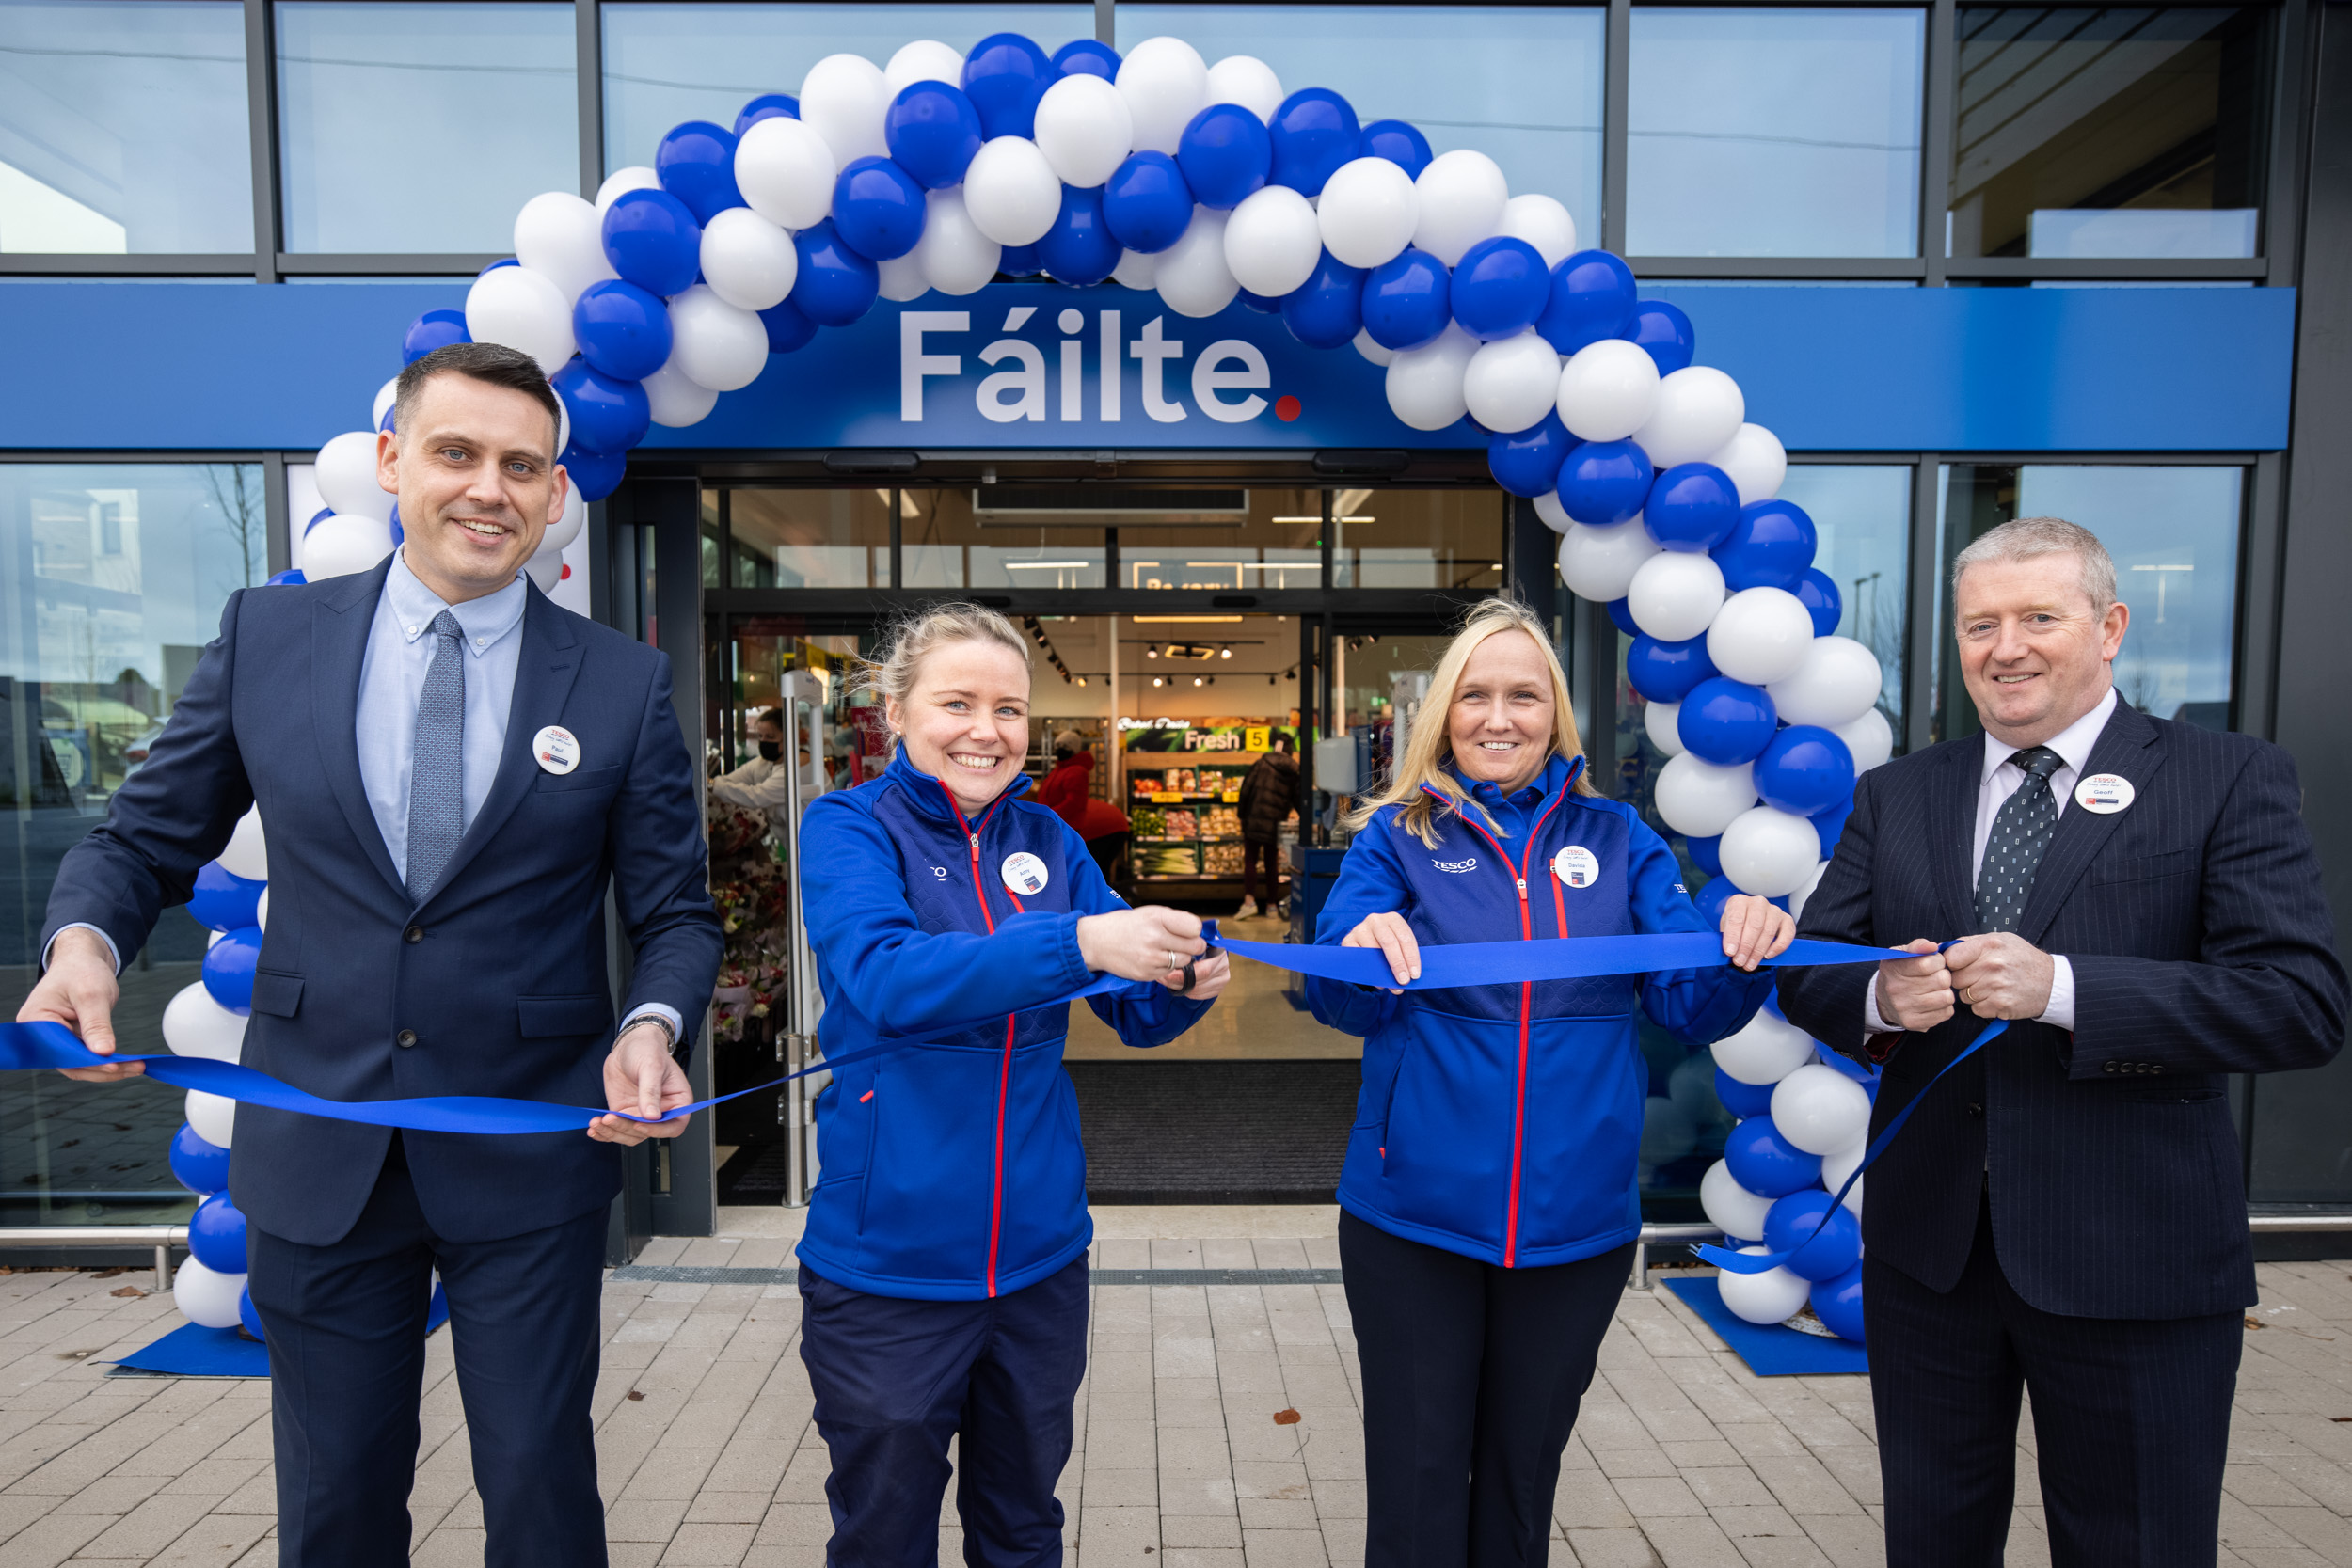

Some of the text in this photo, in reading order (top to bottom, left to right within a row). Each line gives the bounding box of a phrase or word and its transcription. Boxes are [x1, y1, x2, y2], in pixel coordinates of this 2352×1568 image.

[900, 307, 1302, 423] Fáilte.
[551, 729, 570, 739] TESCO
[1184, 730, 1263, 750] Fresh 5
[551, 744, 564, 753] Paul
[1008, 854, 1025, 865] TESCO
[1431, 857, 1476, 870] TESCO
